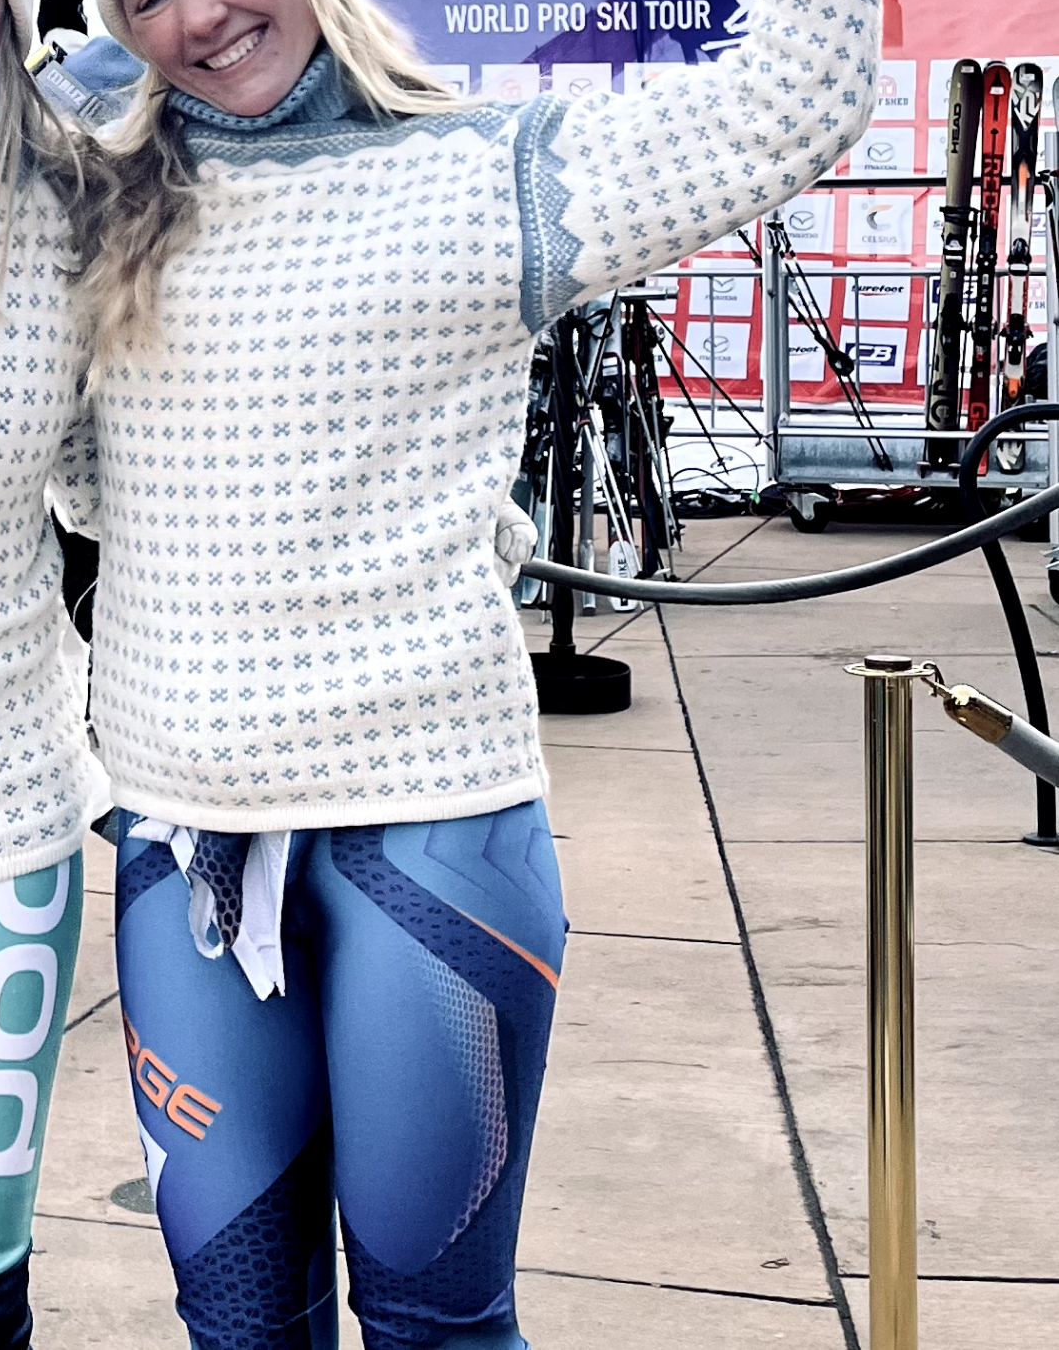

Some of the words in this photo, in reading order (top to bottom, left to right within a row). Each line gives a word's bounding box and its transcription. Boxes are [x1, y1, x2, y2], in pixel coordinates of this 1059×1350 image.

[444, 4, 530, 33] WORLD
[537, 2, 586, 32] PRO
[597, 1, 638, 31] SKI
[644, 0, 711, 30] TOUR
[951, 102, 962, 154] HEAD
[861, 235, 898, 244] CELSIUS
[848, 344, 893, 362] CB
